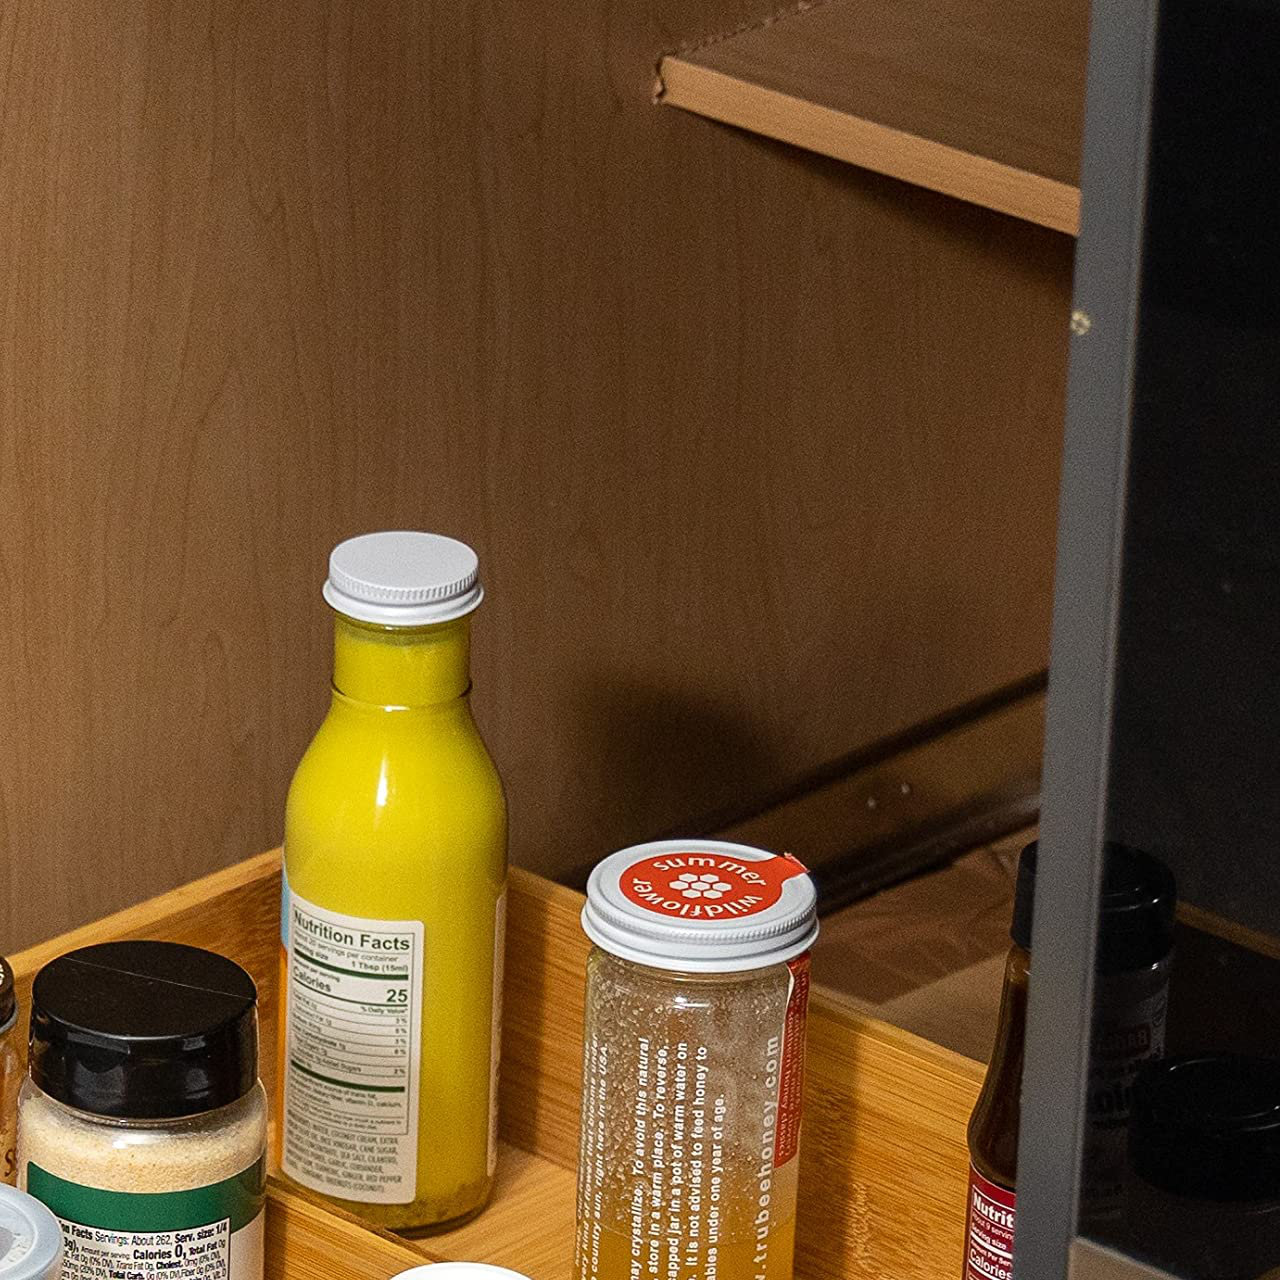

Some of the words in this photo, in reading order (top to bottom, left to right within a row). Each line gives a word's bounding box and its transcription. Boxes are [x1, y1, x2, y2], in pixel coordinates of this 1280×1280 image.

[653, 856, 767, 888] summer
[633, 877, 763, 918] wildflower
[293, 910, 354, 946] Nutrition
[360, 934, 410, 951] Facts
[293, 966, 332, 992] Calories
[386, 989, 408, 1003] 25
[599, 1042, 608, 1075] USA.
[638, 1037, 649, 1086] natural
[677, 1042, 687, 1060] on
[695, 1046, 707, 1061] to
[656, 1045, 669, 1100] reverse,
[675, 1064, 686, 1101] water
[693, 1065, 709, 1106] honey
[598, 1079, 607, 1101] the
[636, 1090, 648, 1115] this
[597, 1104, 606, 1118] in
[653, 1103, 665, 1119] To
[714, 1094, 726, 1122] age.
[595, 1121, 605, 1149] here
[674, 1105, 685, 1141] warm
[691, 1110, 704, 1139] feed
[711, 1126, 722, 1140] of
[635, 1120, 646, 1156] avoid
[653, 1129, 665, 1168] place.
[672, 1143, 683, 1158] of
[692, 1143, 703, 1156] to
[594, 1153, 605, 1186] right
[633, 1160, 644, 1175] To
[711, 1143, 724, 1173] year
[670, 1163, 683, 1184] pot
[689, 1160, 702, 1212] advised
[652, 1173, 662, 1207] warm
[711, 1177, 721, 1202] one
[668, 1200, 680, 1212] in
[973, 1191, 1014, 1228] Nutrit
[71, 1225, 93, 1240] Facts
[95, 1231, 129, 1247] Servings:
[131, 1235, 154, 1246] About
[155, 1235, 173, 1247] 262,
[174, 1232, 195, 1244] Serv.
[196, 1228, 214, 1241] size:
[216, 1221, 227, 1235] 1/4
[648, 1223, 659, 1236] in
[669, 1216, 682, 1235] jar
[688, 1215, 699, 1237] not
[707, 1205, 719, 1243] under
[991, 1226, 1014, 1241] servin
[133, 1249, 172, 1260] Calories
[174, 1244, 187, 1260] 0,
[188, 1245, 206, 1256] Total
[206, 1241, 218, 1251] Fat
[589, 1222, 602, 1272] country
[648, 1239, 659, 1273] store
[686, 1242, 697, 1253] is
[685, 1257, 697, 1266] It
[970, 1248, 1013, 1280] Calories
